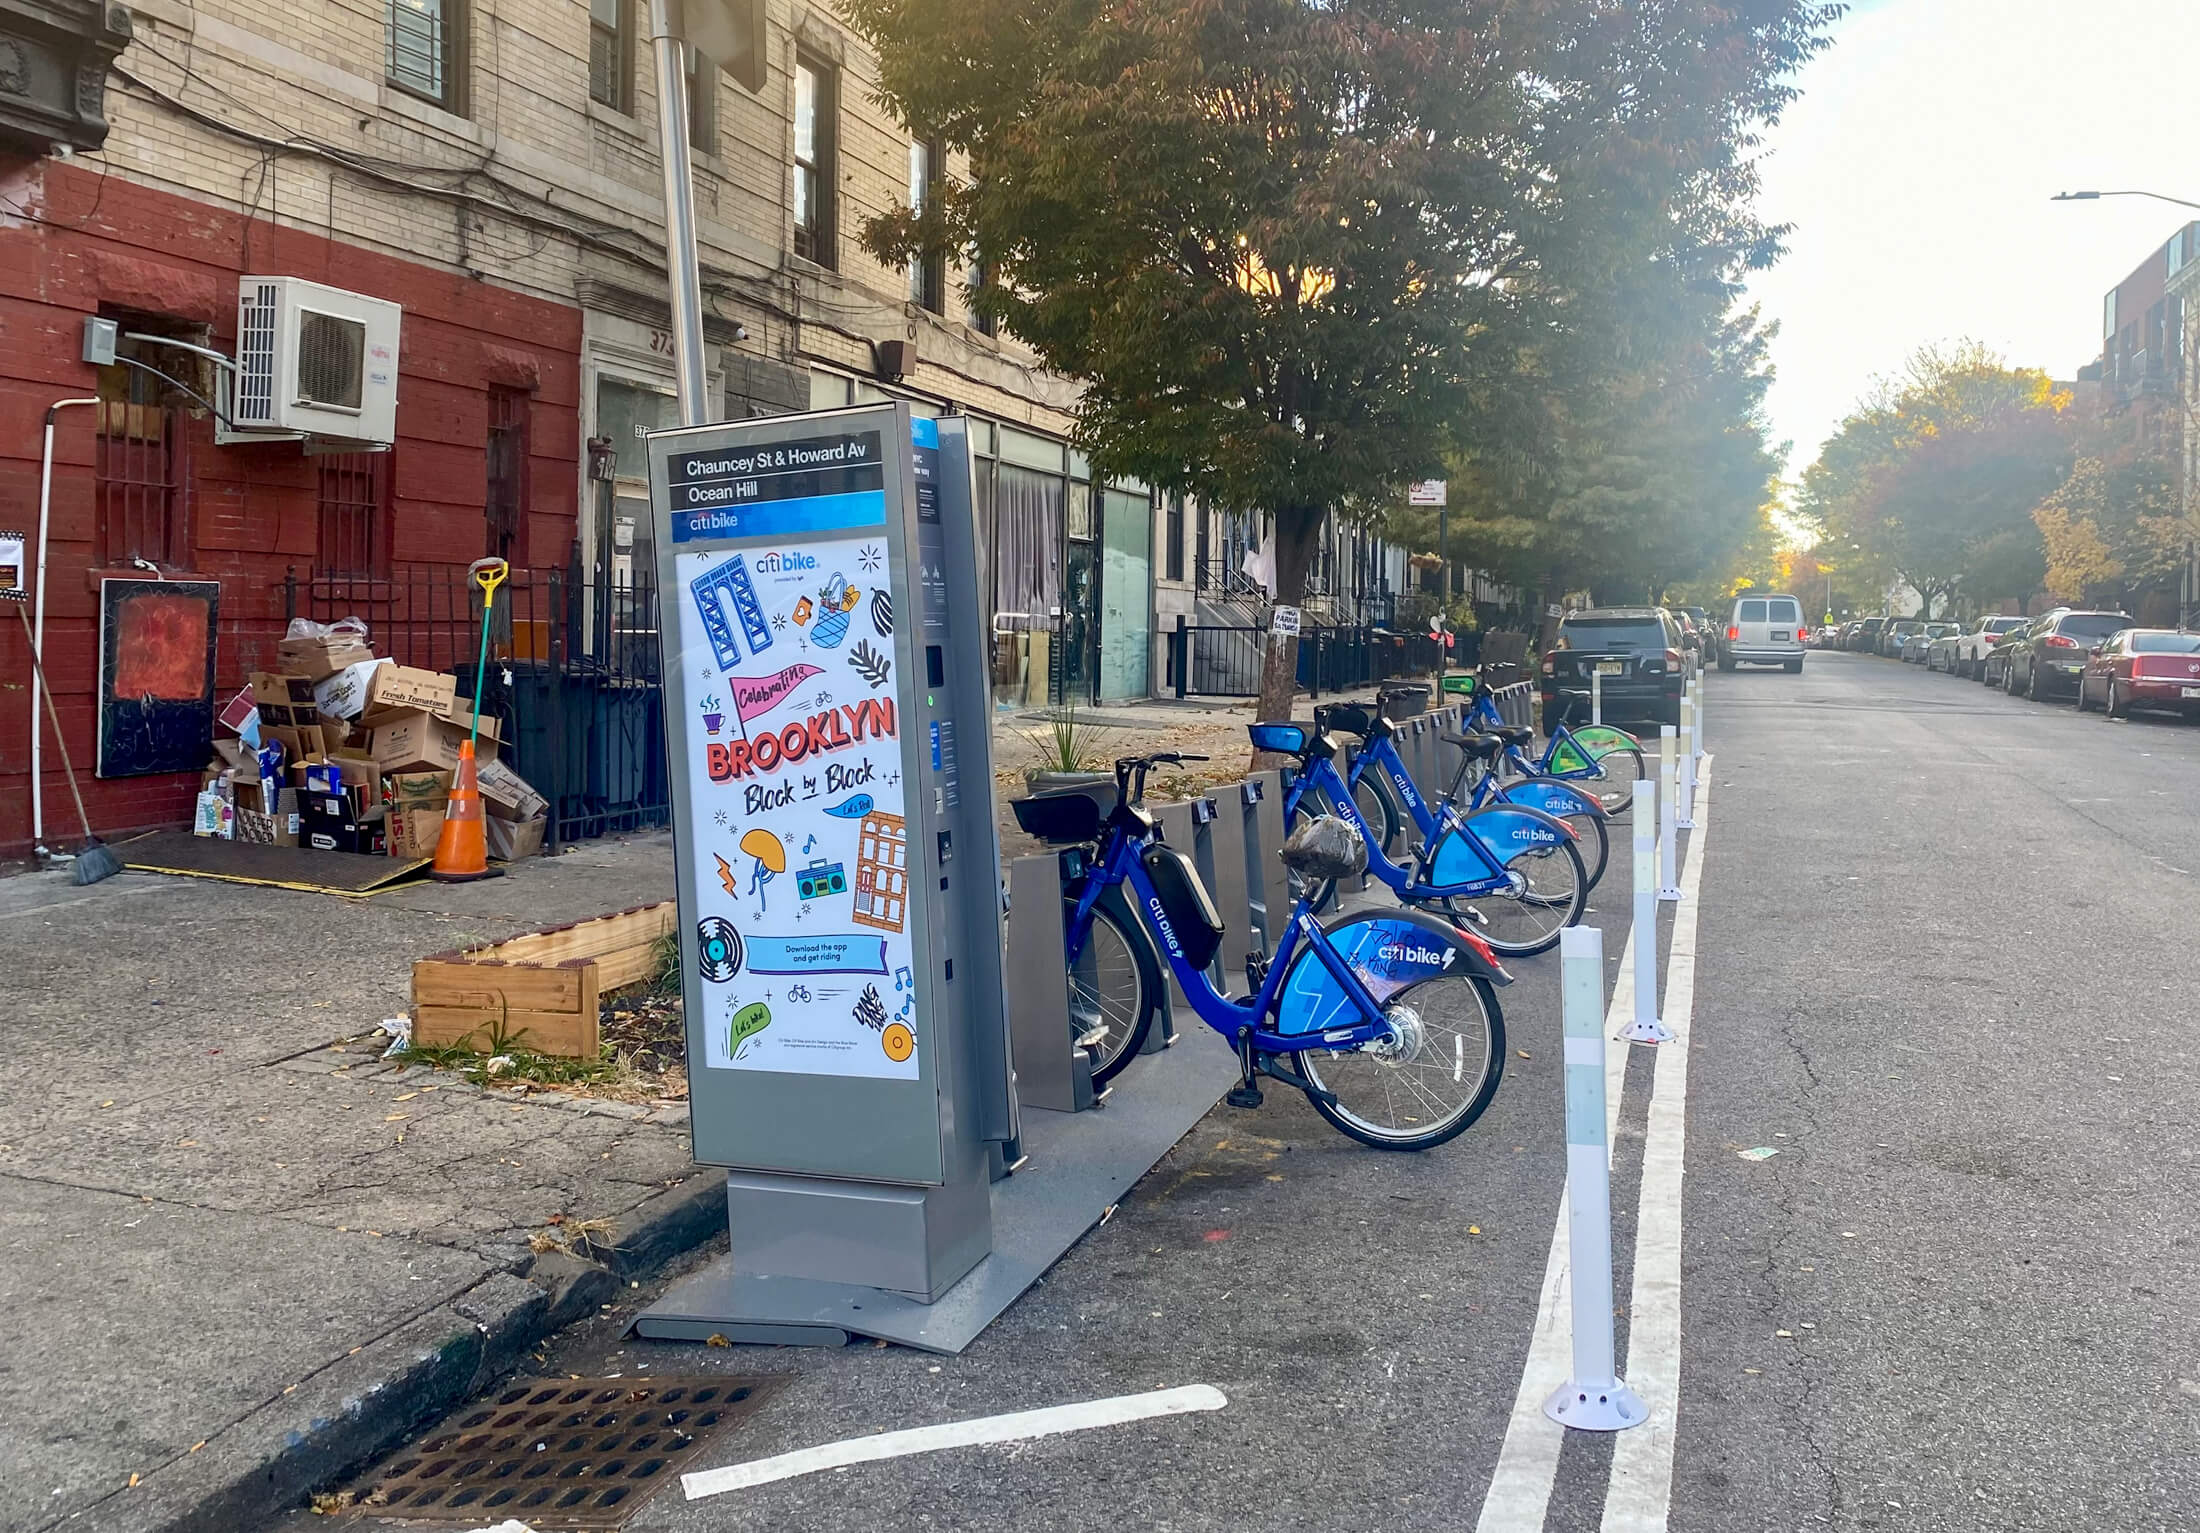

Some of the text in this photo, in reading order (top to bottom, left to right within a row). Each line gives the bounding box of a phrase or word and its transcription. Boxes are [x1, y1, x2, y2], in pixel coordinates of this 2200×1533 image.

[686, 442, 866, 476] Chauncey St & Howard Av
[688, 481, 758, 503] Ocean Hill
[381, 690, 406, 701] Fresh
[738, 666, 807, 709] Celebrating
[706, 697, 898, 783] BROOKLYN
[743, 757, 877, 816] Block by Block
[785, 944, 820, 953] Download
[833, 944, 848, 952] app
[793, 953, 841, 963] and get riding
[1405, 946, 1441, 965] bike
